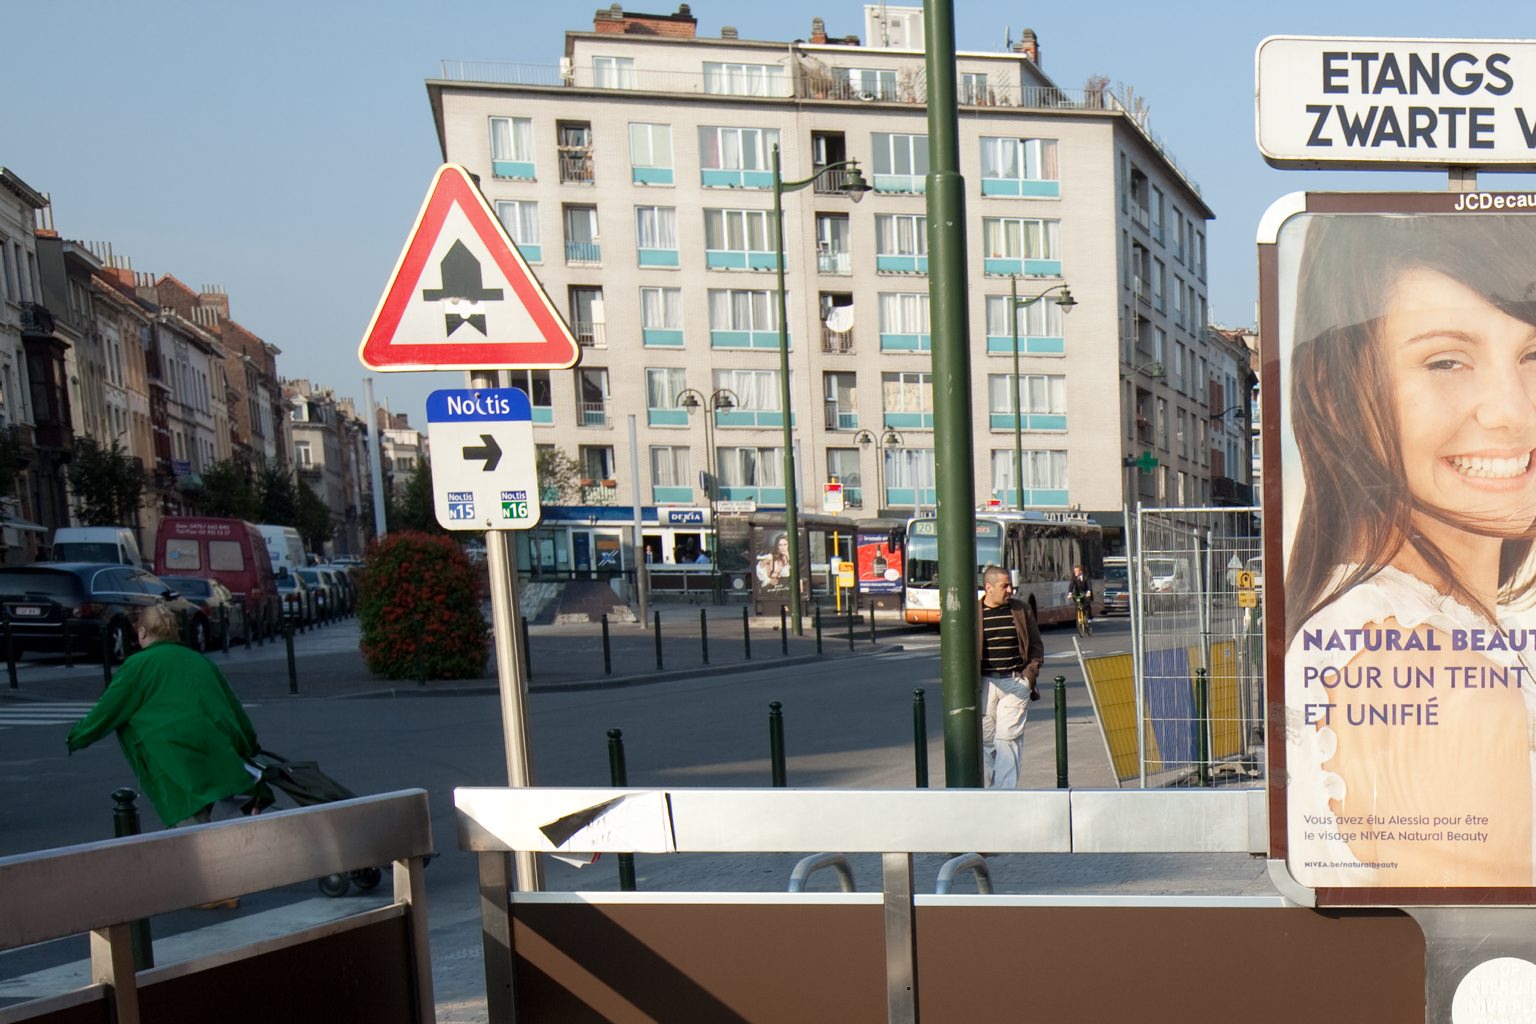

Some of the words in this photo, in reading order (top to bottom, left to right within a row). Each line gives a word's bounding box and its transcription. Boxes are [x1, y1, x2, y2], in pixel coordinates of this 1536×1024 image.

[1322, 51, 1514, 96] ETANGS
[1305, 104, 1496, 149] ZWARTE
[447, 394, 510, 415] Noctis
[450, 505, 474, 519] N15
[503, 503, 528, 518] N16
[671, 511, 700, 522] DEXIA
[918, 523, 931, 532] 20
[1303, 628, 1441, 652] NATURAL
[1303, 666, 1382, 689] POUR
[1393, 666, 1434, 689] UN
[1444, 666, 1528, 689] TEINT
[1303, 703, 1336, 726] ET
[1347, 697, 1439, 726] UNIFIÉ
[1303, 814, 1332, 825] Vous
[1335, 816, 1363, 825] avez
[1366, 813, 1385, 825] élu
[1388, 814, 1430, 825] Alessia
[1433, 816, 1462, 828] pour
[1465, 814, 1489, 825] être
[1304, 831, 1316, 841] le
[1318, 831, 1357, 844] visage
[1360, 831, 1395, 841] NIVEA
[1398, 831, 1443, 841] Natural
[1447, 831, 1489, 843] Beauty
